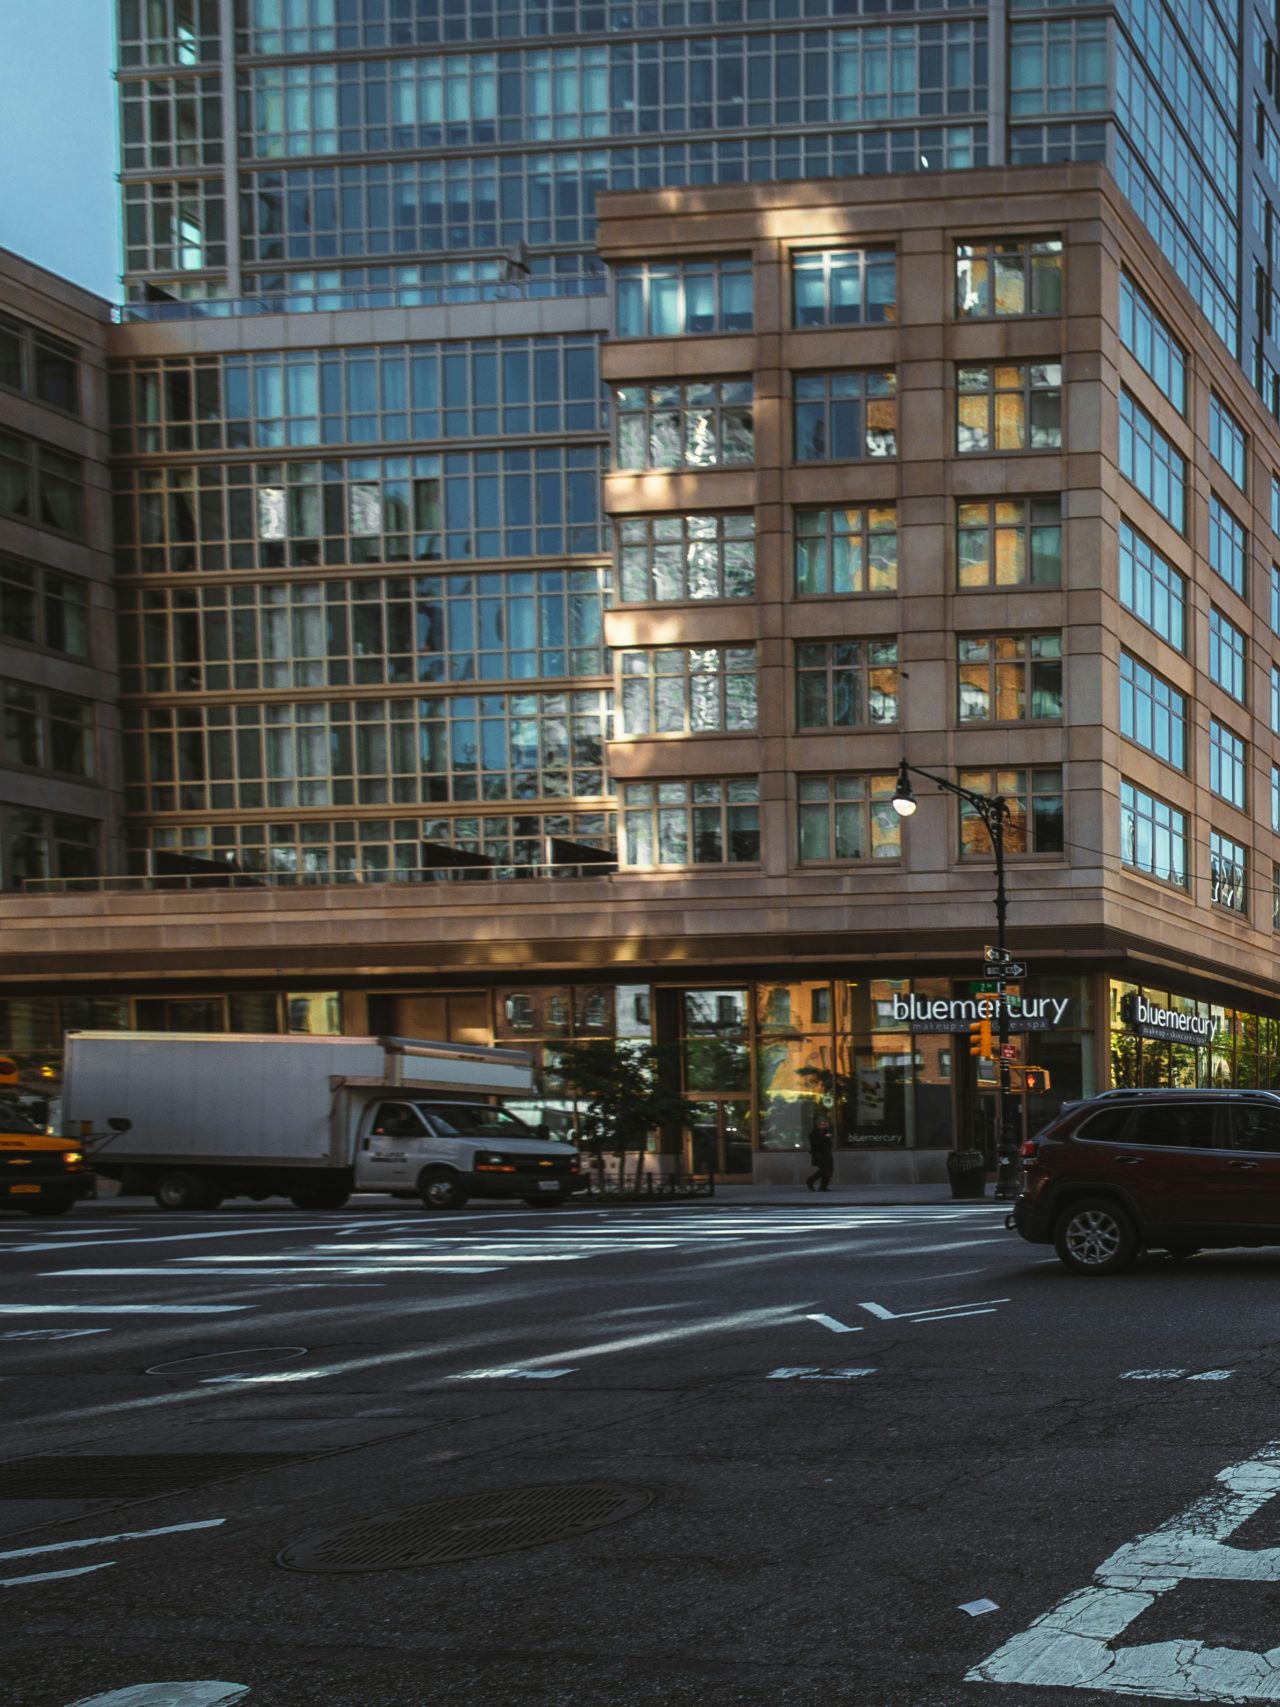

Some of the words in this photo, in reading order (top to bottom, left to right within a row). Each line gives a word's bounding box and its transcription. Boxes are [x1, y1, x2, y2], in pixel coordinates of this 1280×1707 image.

[892, 993, 1069, 1024] bluemercury
[1137, 996, 1217, 1042] bluemercury
[913, 1021, 956, 1032] makeup
[1027, 1021, 1046, 1031] spa
[847, 1132, 904, 1145] bluemercury
